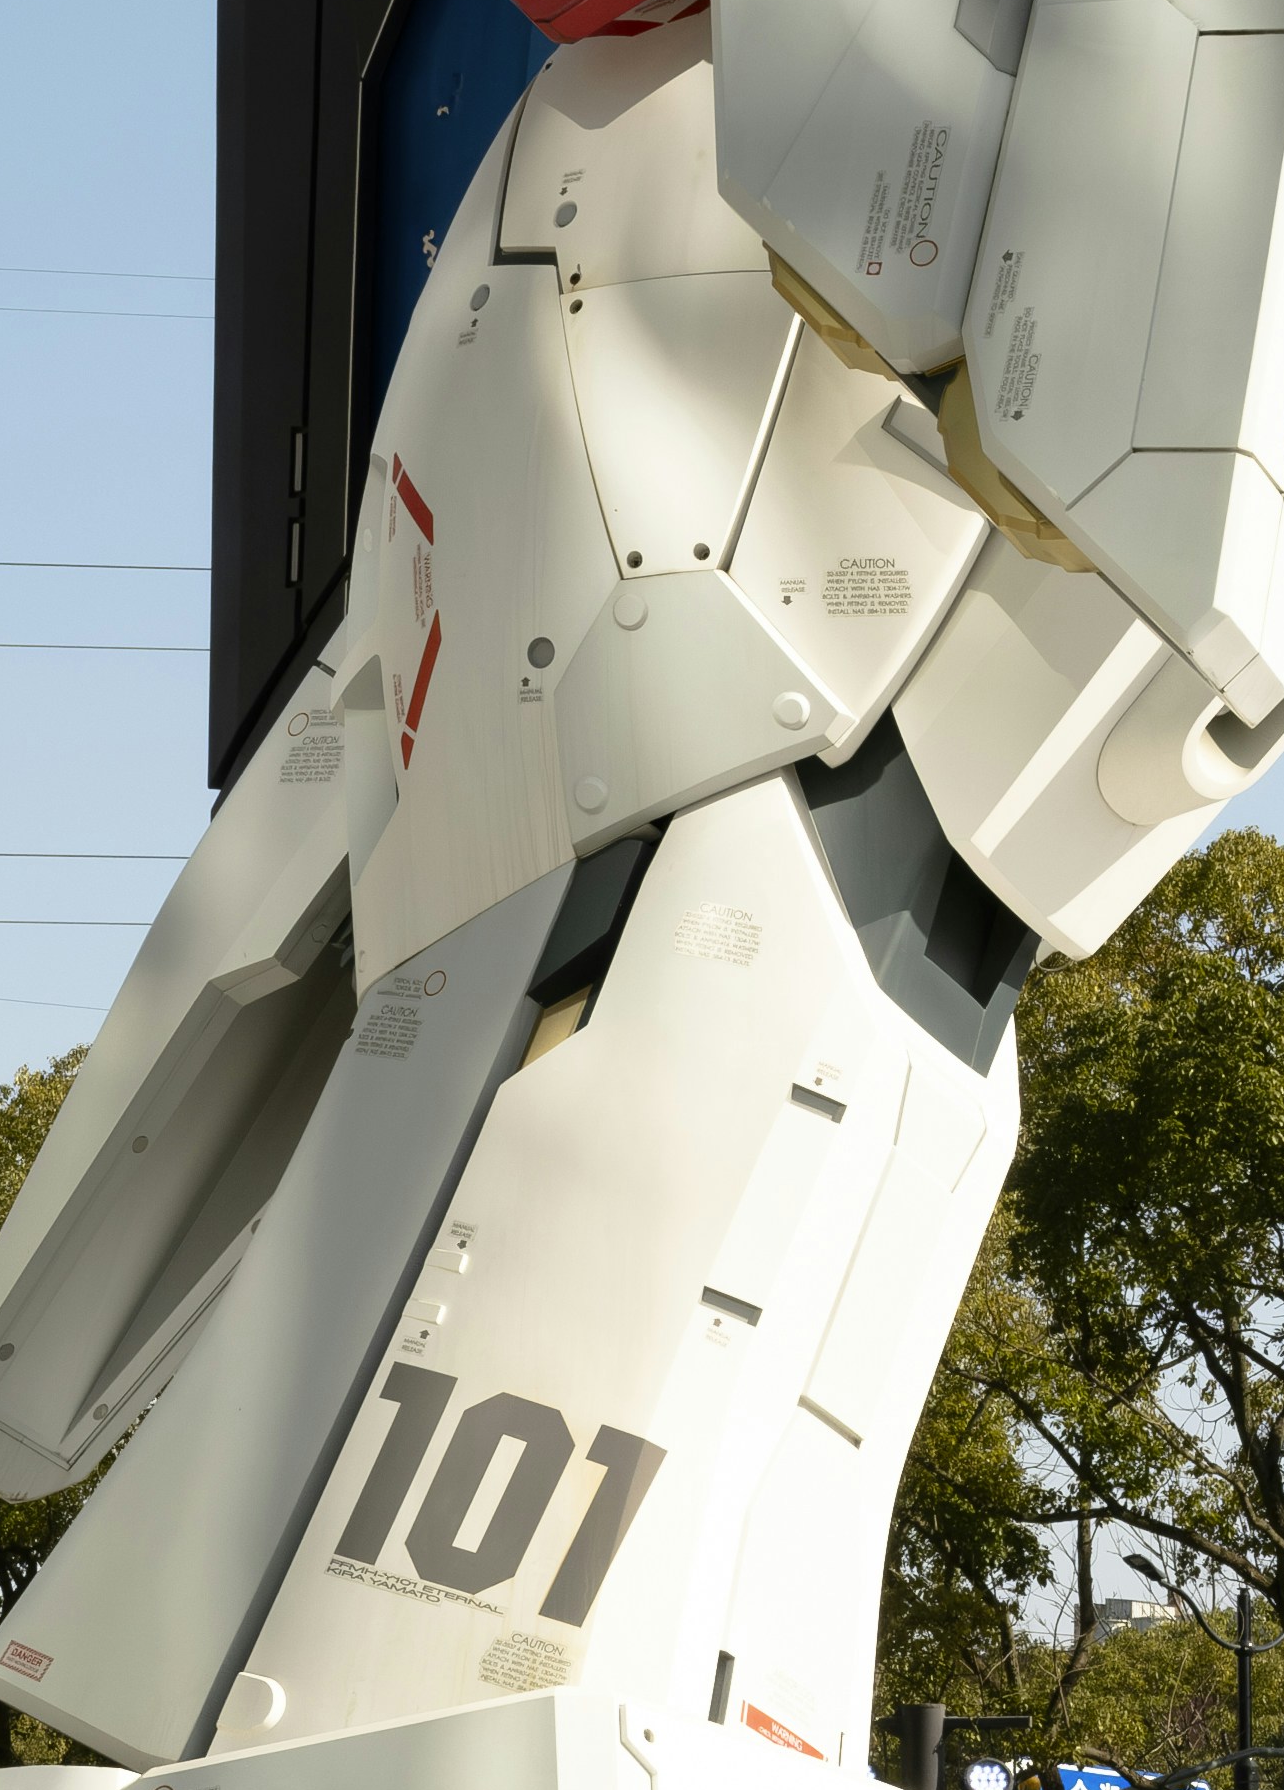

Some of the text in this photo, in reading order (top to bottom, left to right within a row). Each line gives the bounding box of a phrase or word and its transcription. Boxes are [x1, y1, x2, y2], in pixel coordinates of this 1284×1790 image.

[915, 128, 948, 238] CAUTION
[1018, 353, 1039, 407] CAUTION
[839, 558, 895, 569] CAUTION
[302, 735, 339, 745] CAUTION
[699, 902, 753, 922] CAUTION
[334, 1362, 666, 1627] 101
[325, 1564, 441, 1605] KIRA YAMATO
[421, 1582, 505, 1617] ETERNAL
[10, 1647, 43, 1667] DANGER
[511, 1631, 564, 1657] CAUTION
[769, 1720, 805, 1751] WARNING
